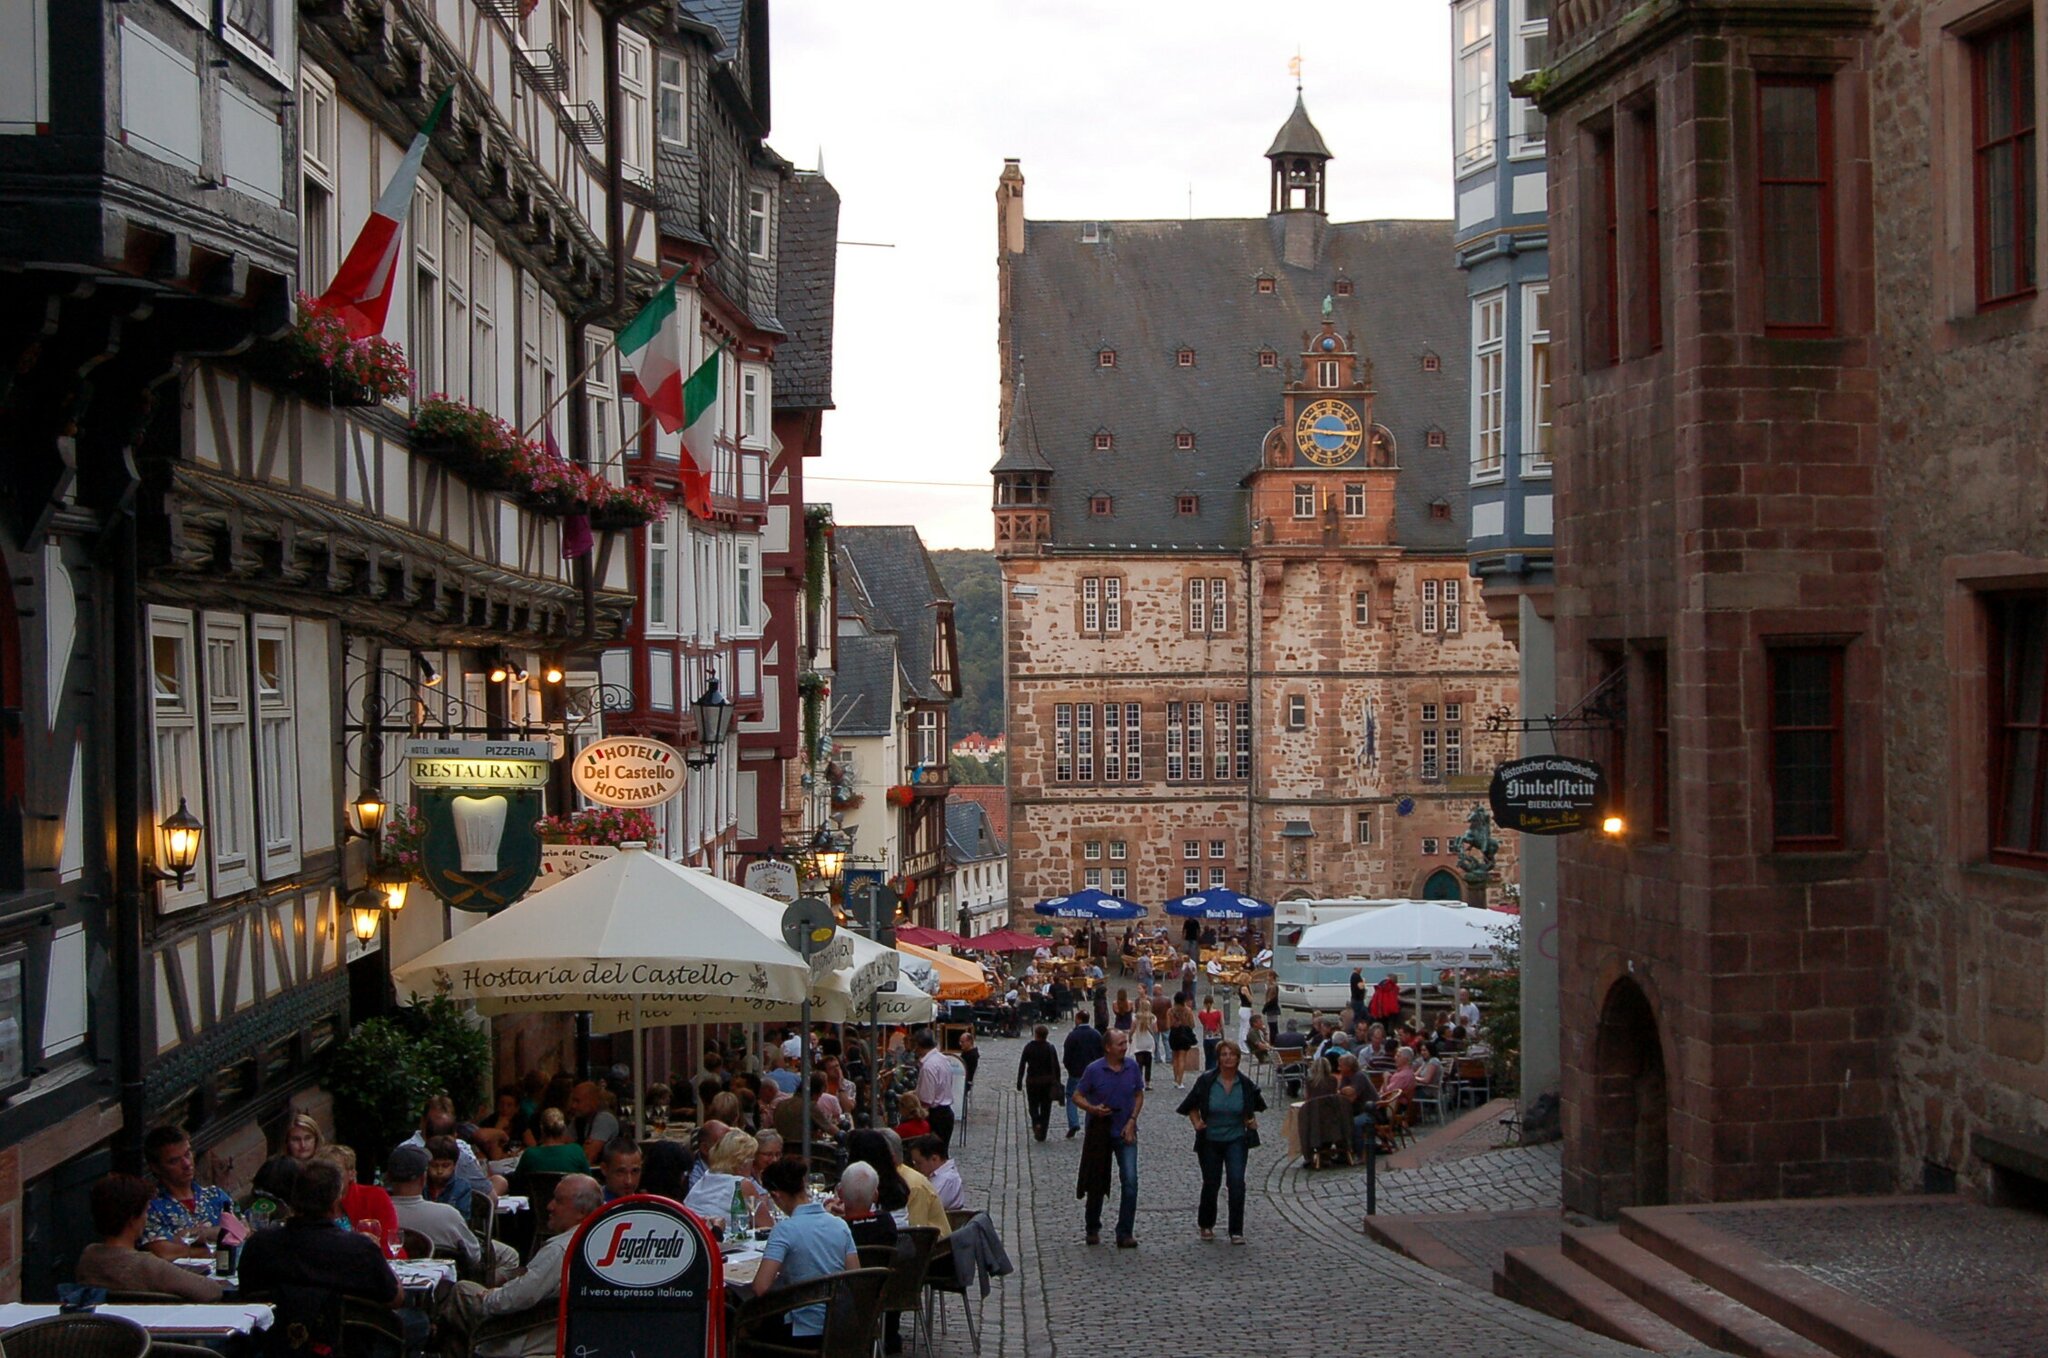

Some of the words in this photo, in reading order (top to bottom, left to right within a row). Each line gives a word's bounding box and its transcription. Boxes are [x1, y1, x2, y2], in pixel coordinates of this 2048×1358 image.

[411, 746, 429, 754] HOTEL
[434, 746, 459, 755] EINGANG
[485, 746, 536, 756] PIZZERIA
[605, 744, 653, 762] HOTEL
[416, 763, 541, 779] RESTAURANT
[584, 765, 610, 779] Del
[614, 765, 675, 780] Castello
[594, 781, 667, 801] HOSTARIA
[1528, 801, 1573, 809] BIERLOKAL
[462, 965, 580, 990] Hostaria
[582, 962, 631, 985] del
[631, 964, 740, 987] Castello
[596, 1222, 685, 1267] Segafredo
[634, 1258, 667, 1266] ZANETTI
[580, 1287, 587, 1297] il
[590, 1289, 611, 1297] vero
[613, 1289, 655, 1299] espresso
[657, 1287, 694, 1298] italiano
